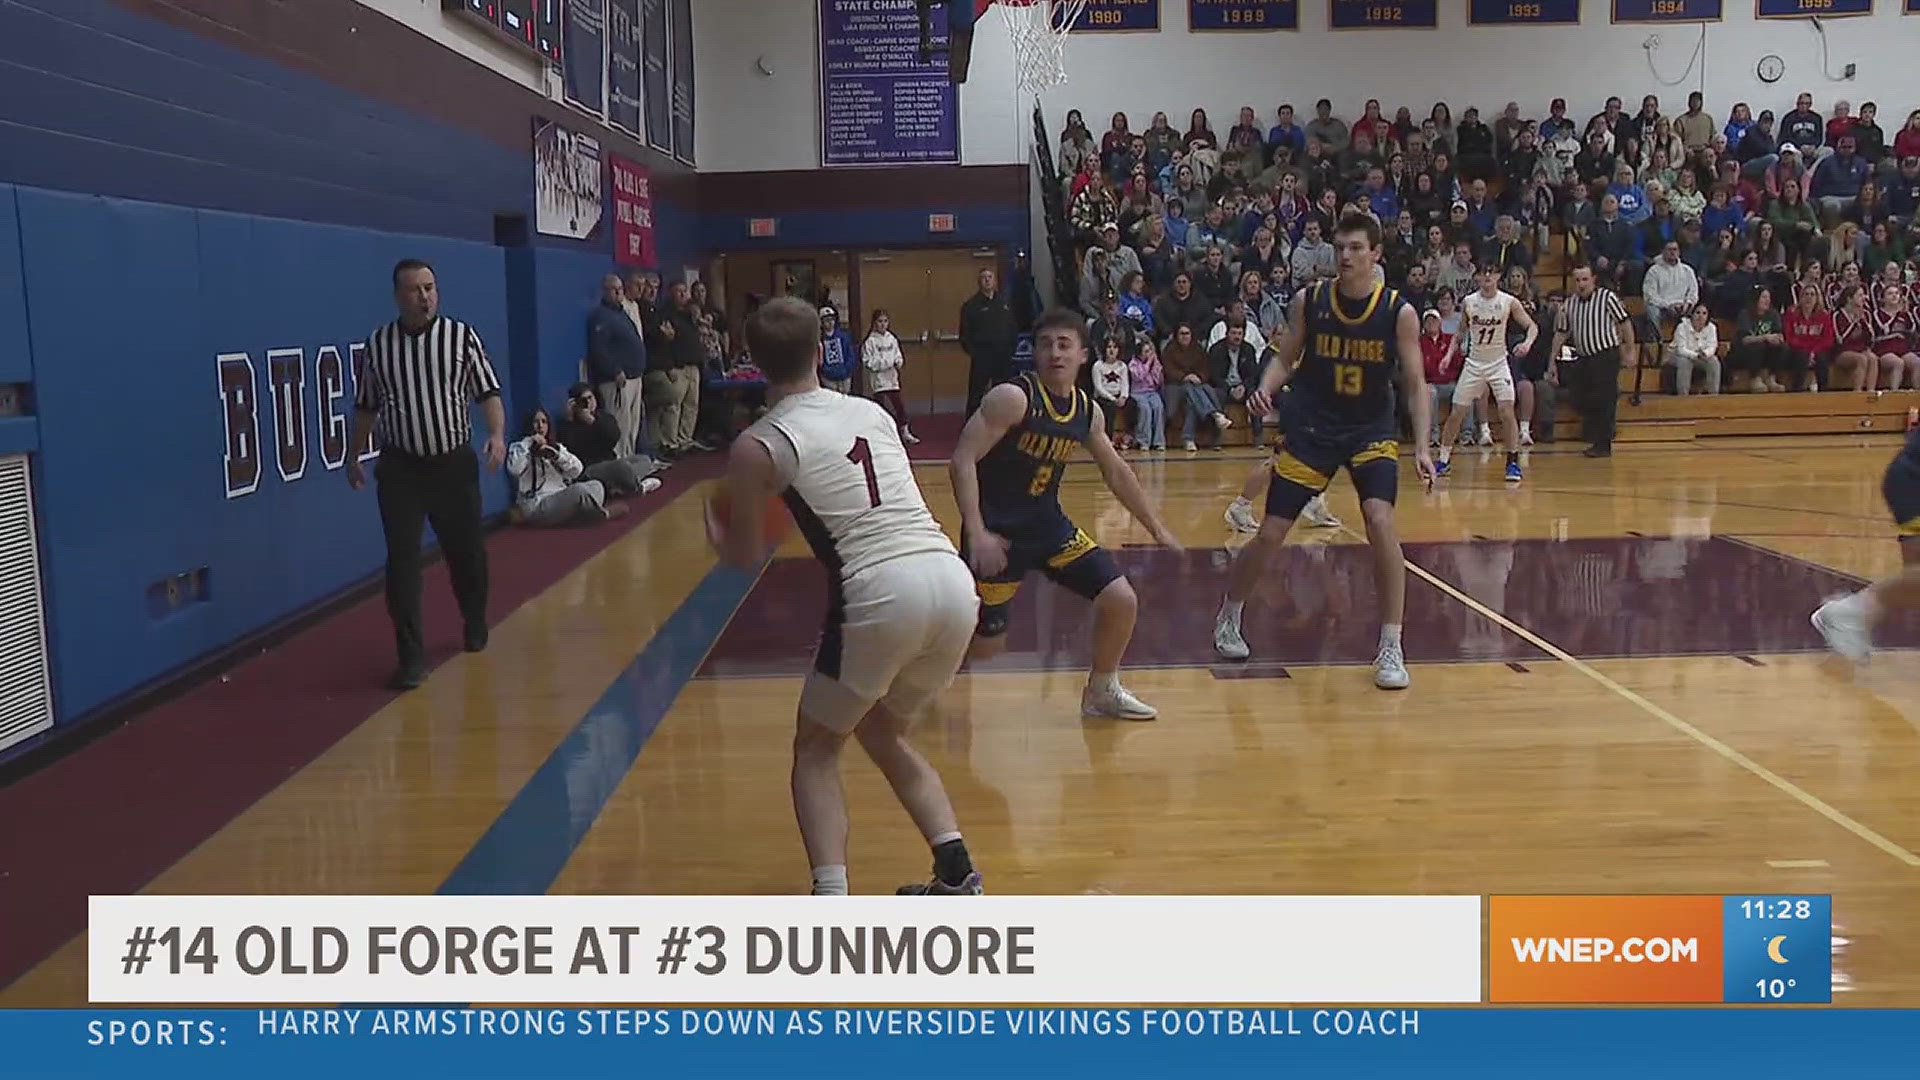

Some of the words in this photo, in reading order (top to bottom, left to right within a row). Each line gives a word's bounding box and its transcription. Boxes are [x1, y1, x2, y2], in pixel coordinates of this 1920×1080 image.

[835, 1, 871, 11] STATE
[1365, 7, 1402, 21] 1992
[1650, 1, 1684, 14] 1994
[1088, 10, 1122, 24] 1980
[1222, 9, 1265, 23] 1989
[1478, 327, 1496, 345] 11
[1316, 334, 1341, 359] OLD
[1344, 337, 1385, 362] FORGE
[1334, 364, 1364, 395] 13
[217, 342, 381, 499] BUC
[846, 435, 881, 509] 1
